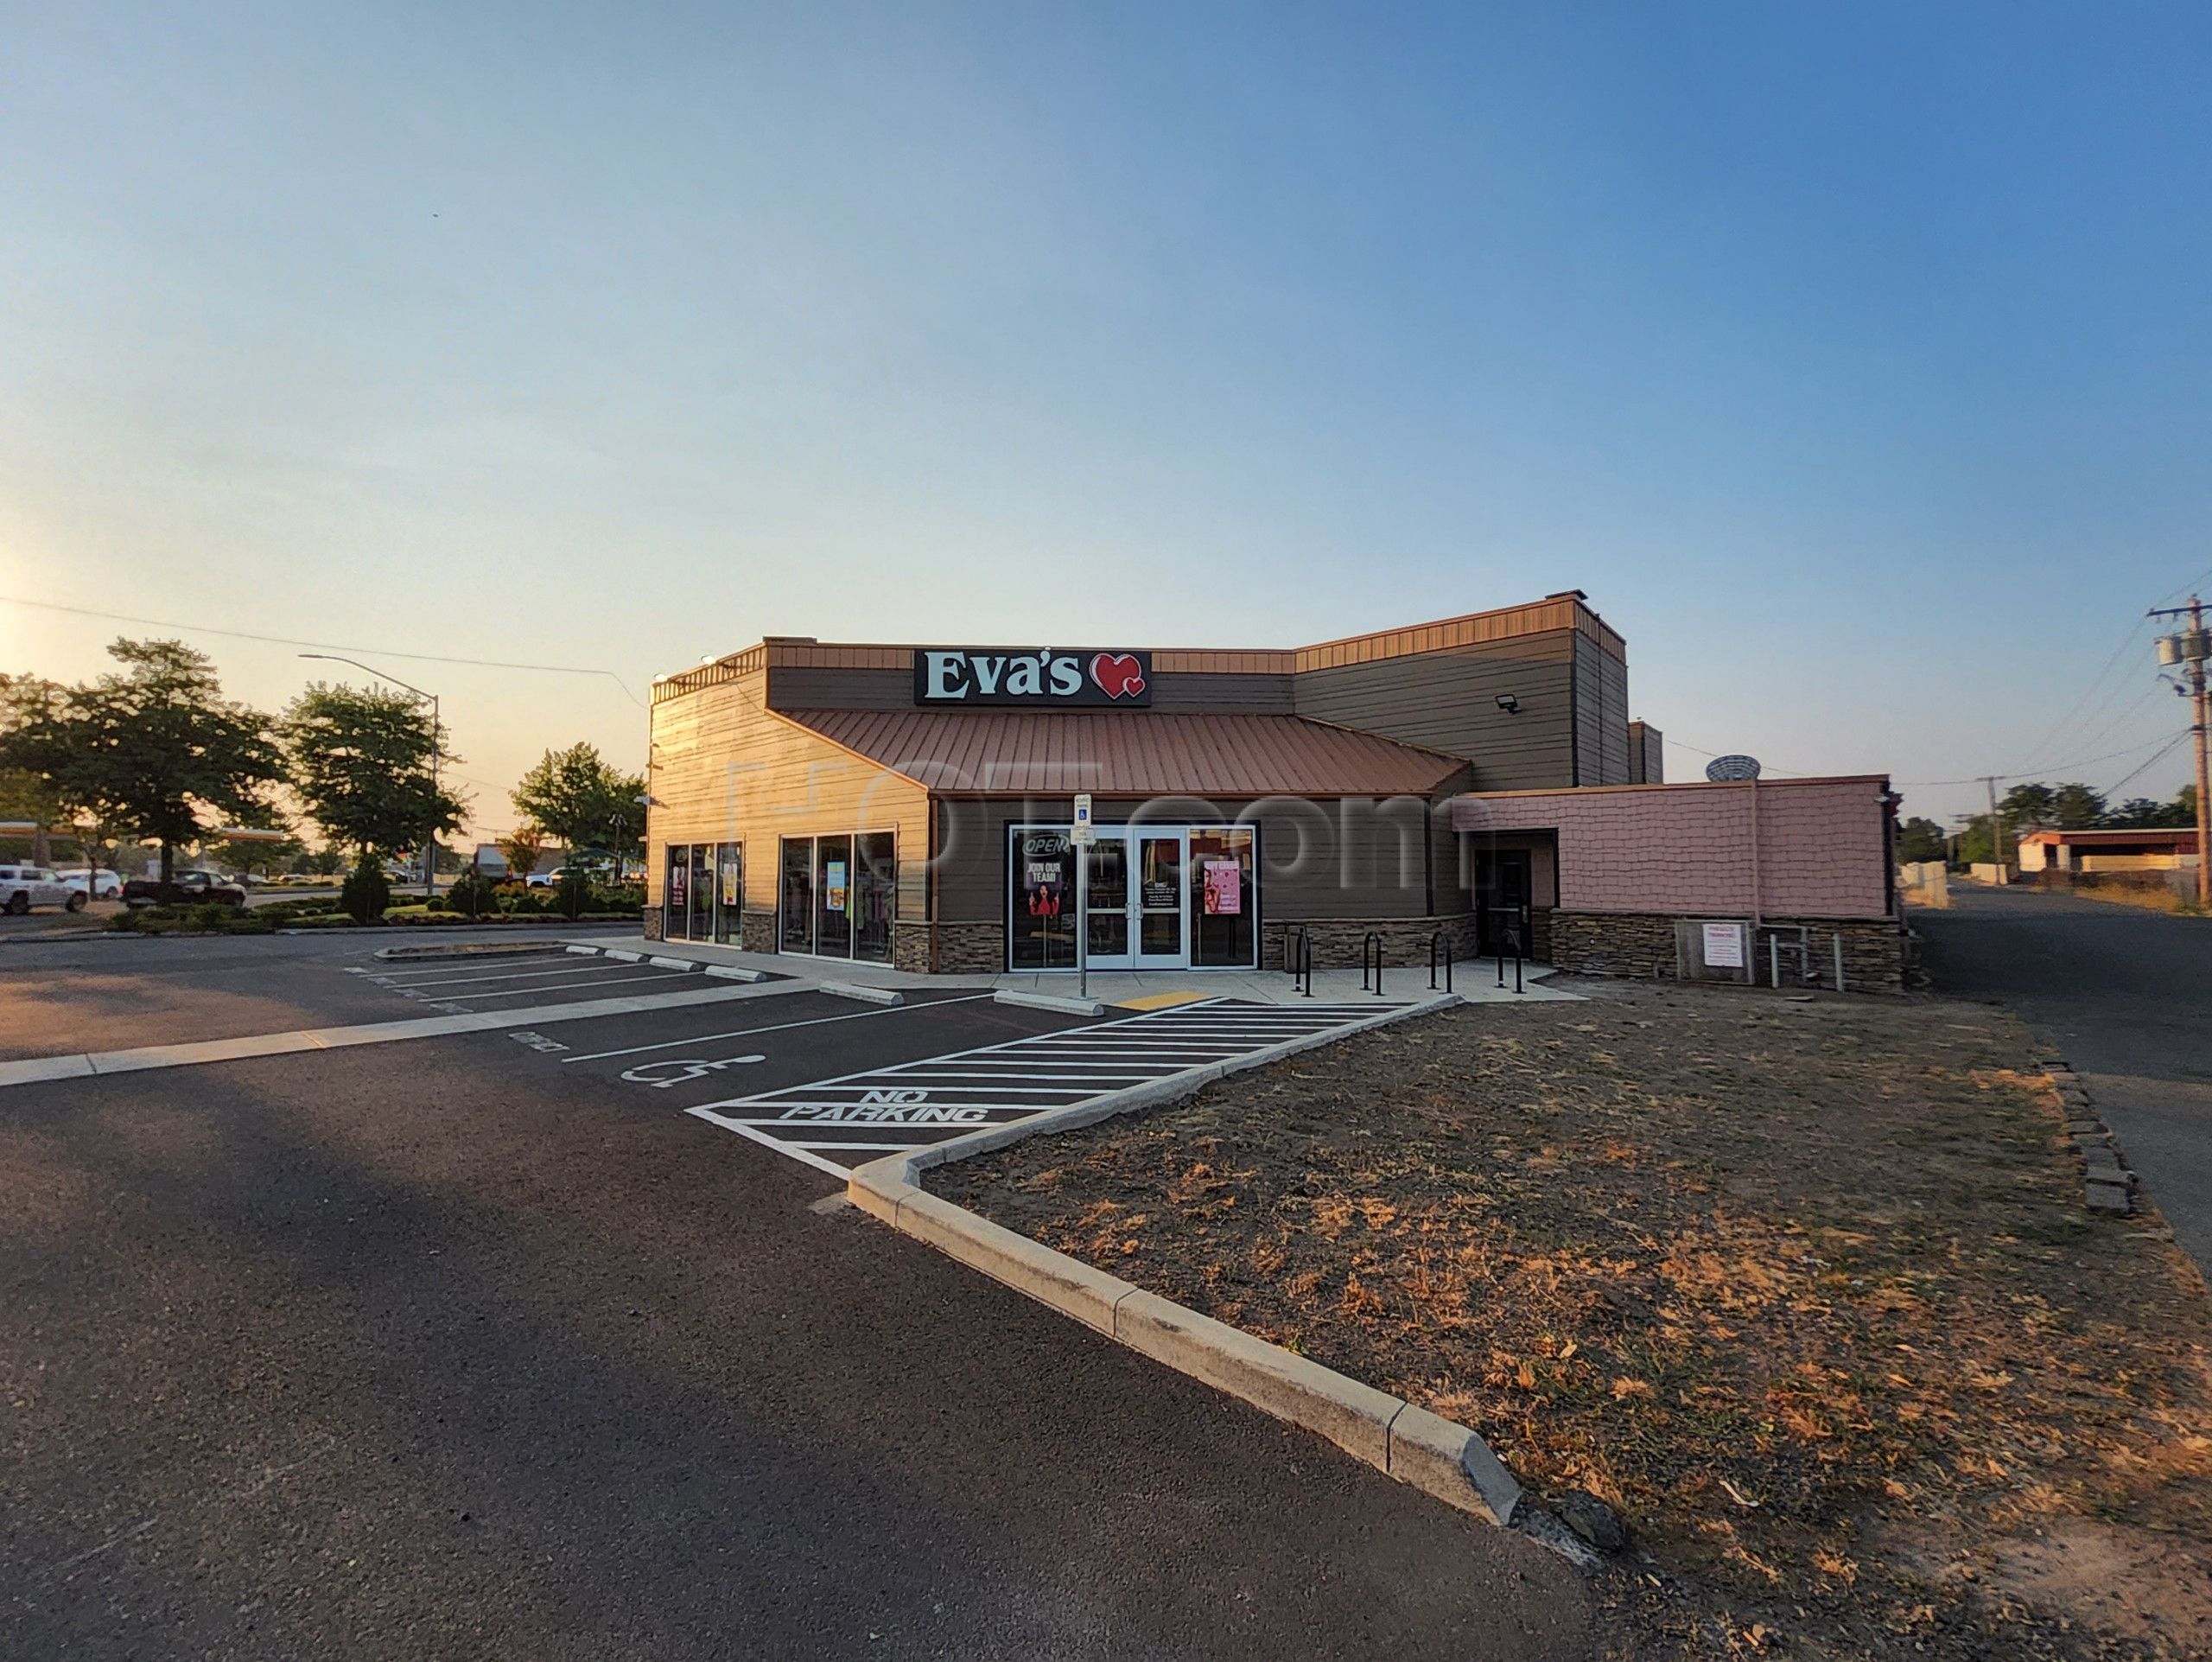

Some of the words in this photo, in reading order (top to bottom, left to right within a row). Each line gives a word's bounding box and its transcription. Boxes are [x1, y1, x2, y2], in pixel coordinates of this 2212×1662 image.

[924, 651, 1083, 699] Eva's
[1026, 838, 1065, 853] OPEN
[1027, 863, 1044, 872] JOIN
[1046, 863, 1061, 872] OUR
[860, 1091, 928, 1104] NO
[779, 1106, 988, 1122] PARKING
